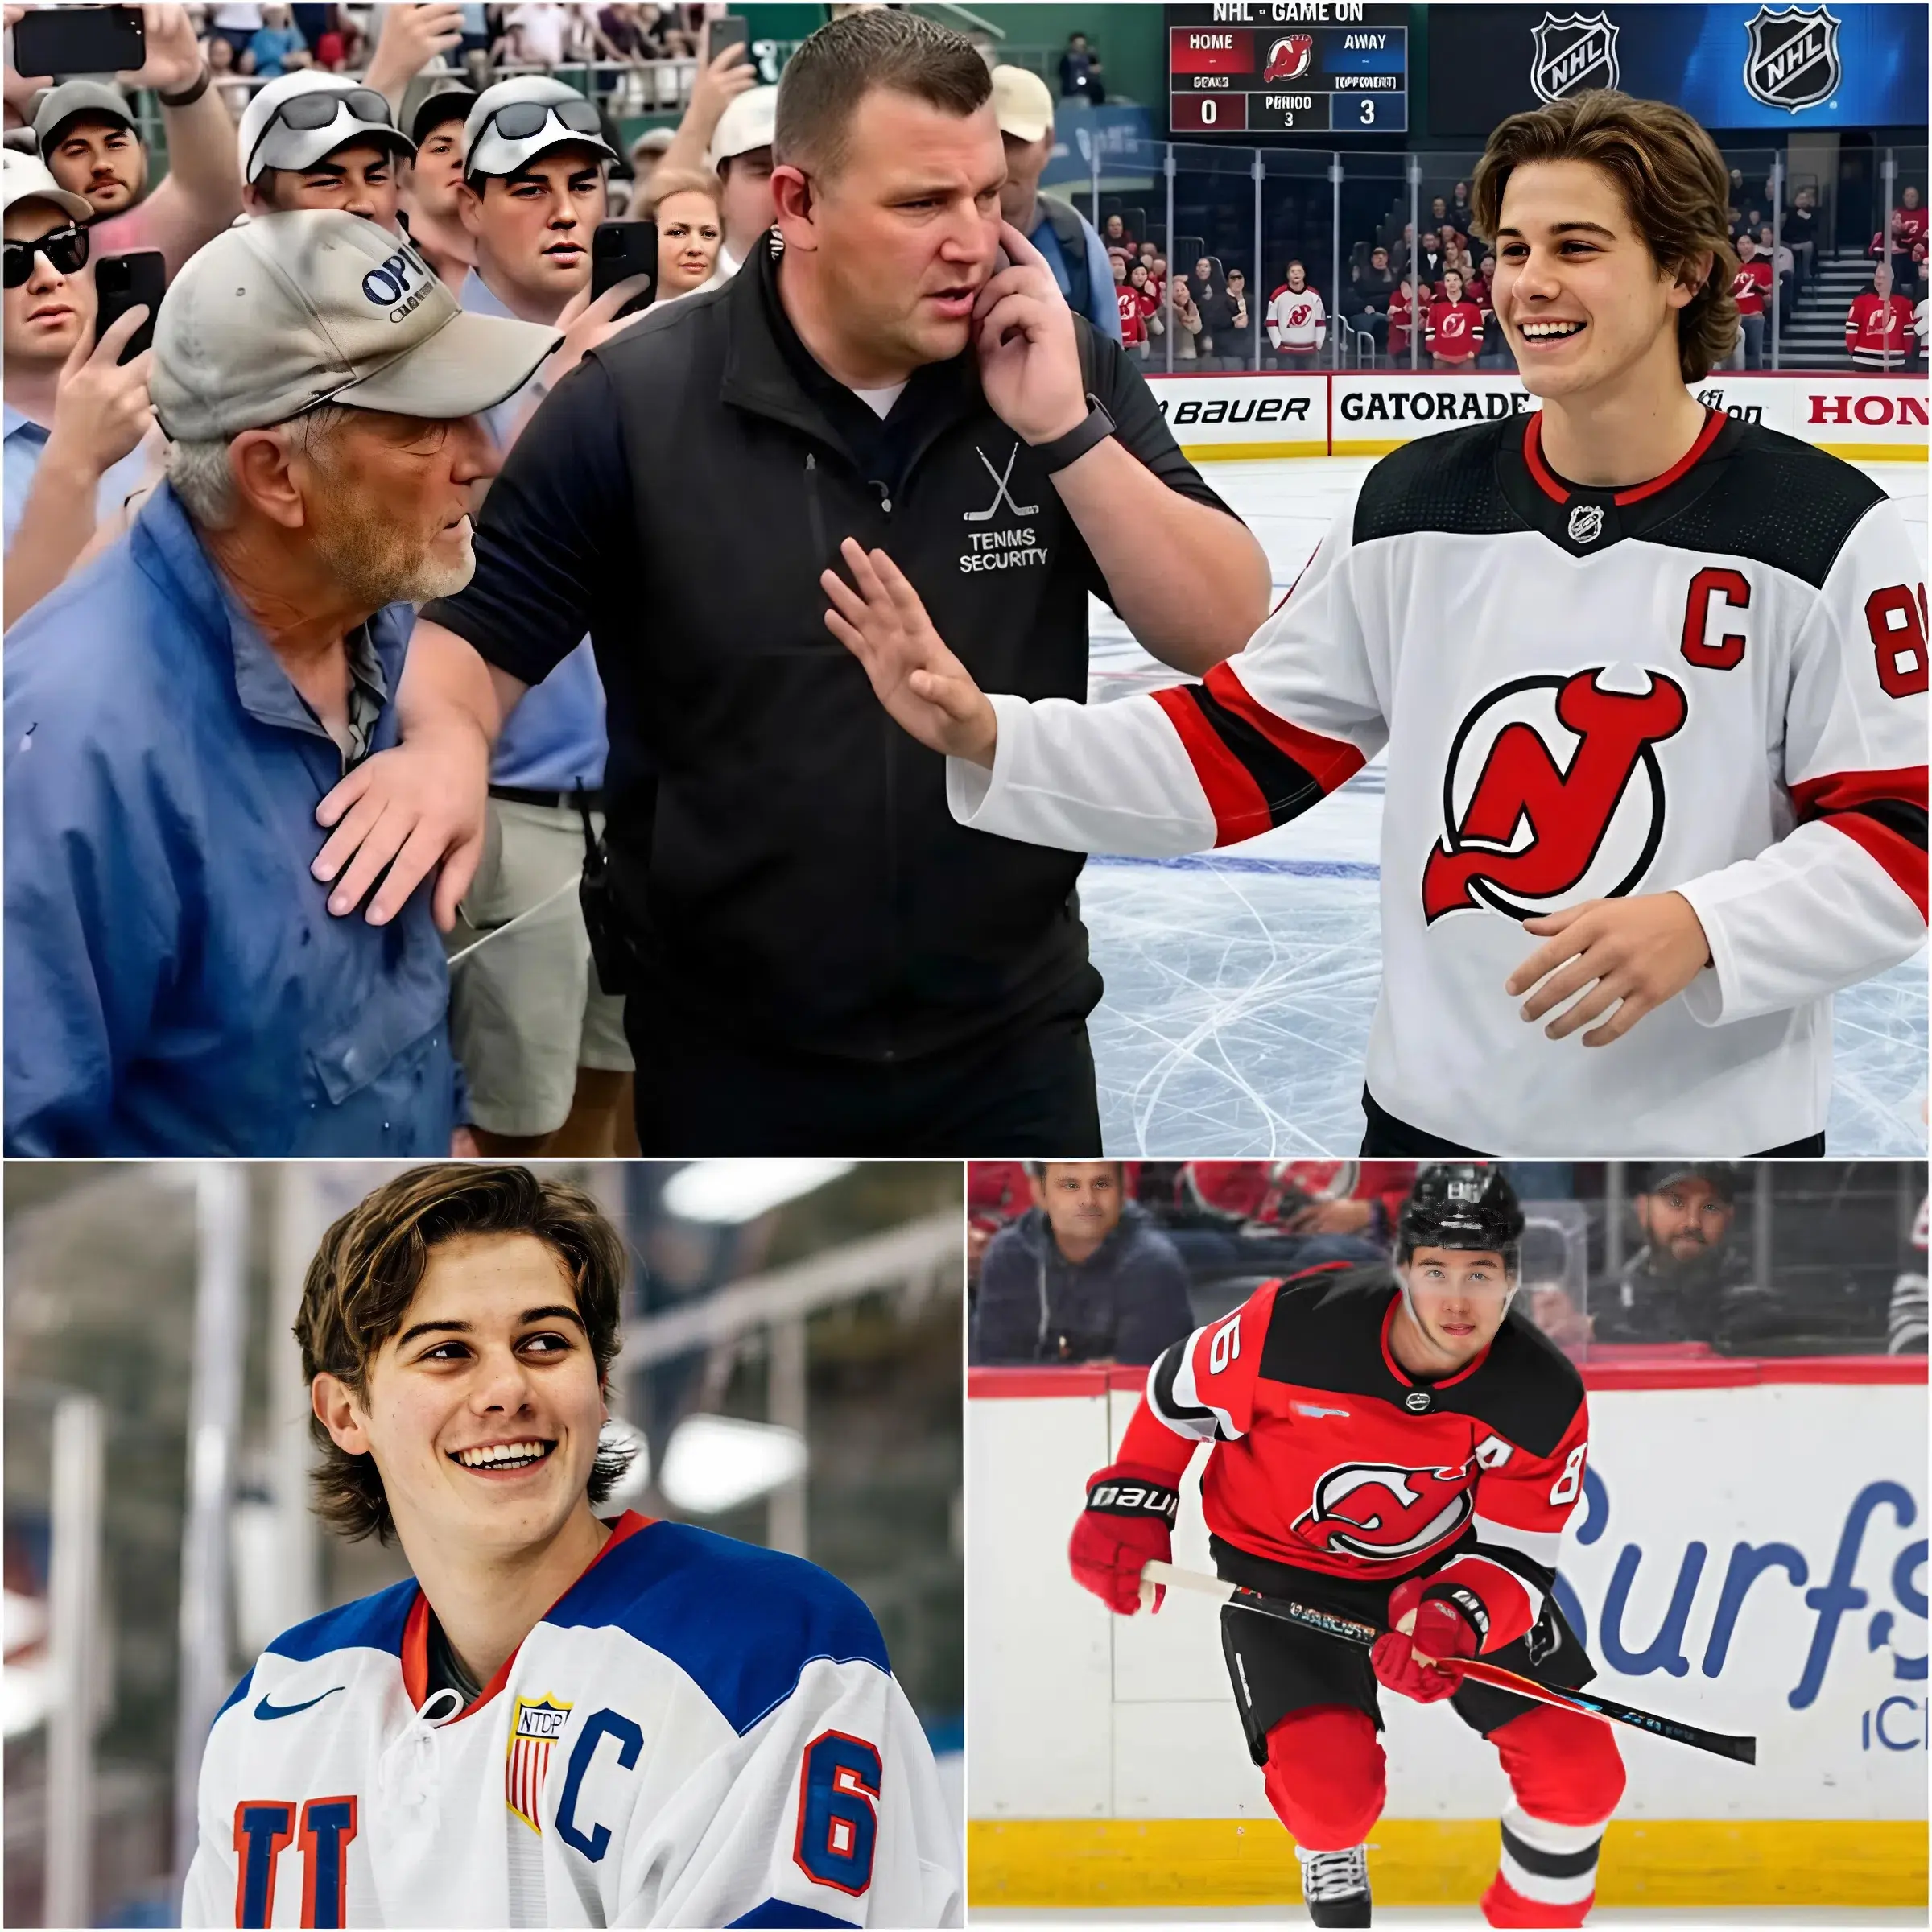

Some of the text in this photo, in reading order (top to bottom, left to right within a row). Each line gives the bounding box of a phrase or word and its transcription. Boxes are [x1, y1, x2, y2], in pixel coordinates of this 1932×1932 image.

[1213, 2, 1253, 22] NHL
[1272, 2, 1330, 22] GAME
[1335, 2, 1364, 22] ON
[1189, 34, 1232, 50] HOME
[1344, 34, 1386, 50] AWAY
[1551, 39, 1603, 90] NHL
[1767, 33, 1822, 89] NHL
[1201, 99, 1217, 124] 0
[1284, 112, 1294, 126] 3
[1360, 99, 1375, 124] 3
[1340, 391, 1530, 421] GATORADE
[1807, 395, 1929, 426] HON
[960, 548, 1048, 573] SECURITY
[1680, 566, 1752, 671] C
[1864, 581, 1929, 700] 8
[521, 1708, 563, 1735] NTDP
[1861, 1695, 1929, 1752] IC
[555, 1707, 645, 1864] C
[792, 1728, 883, 1898] 6
